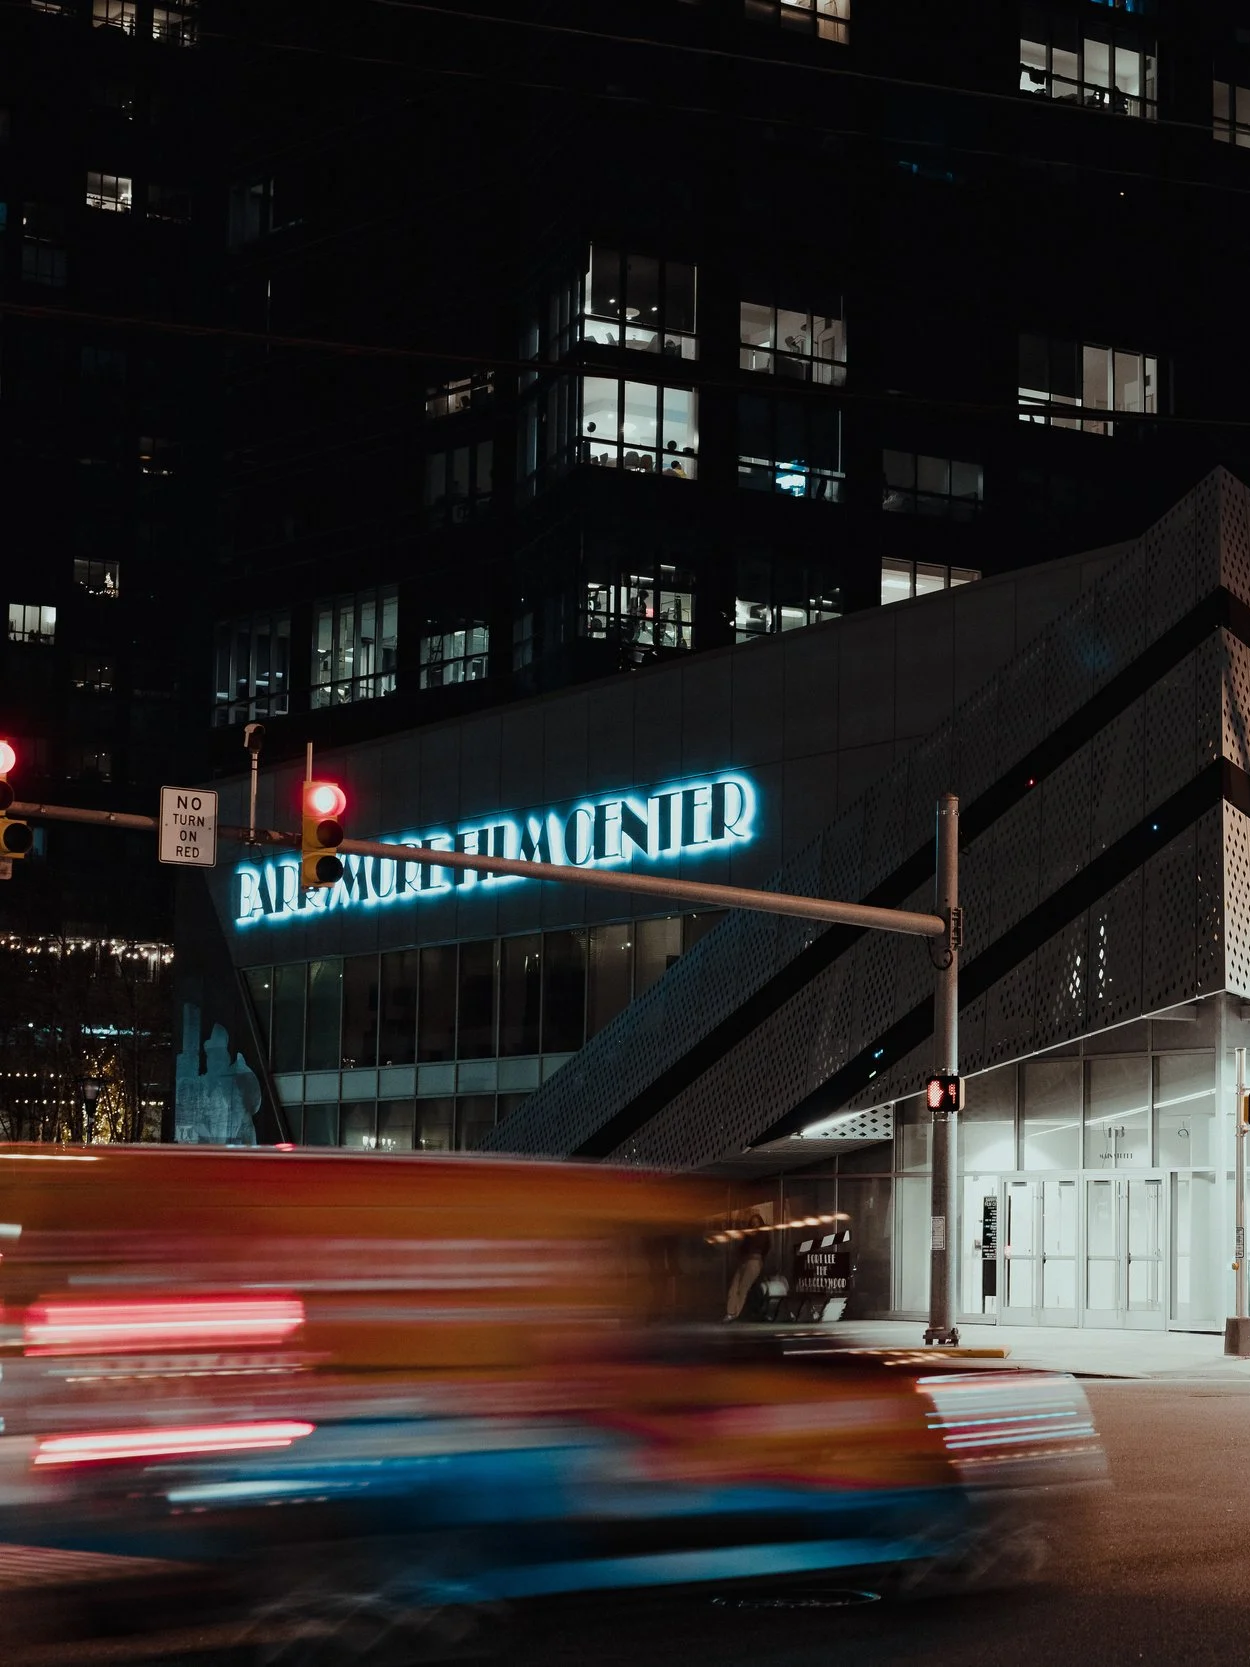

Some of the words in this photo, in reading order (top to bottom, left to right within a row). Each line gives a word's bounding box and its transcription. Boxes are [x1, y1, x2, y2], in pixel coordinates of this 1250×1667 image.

[177, 795, 202, 811] NO
[173, 813, 205, 827] TURN
[180, 830, 197, 842] ON
[176, 846, 200, 858] RED
[234, 836, 448, 919] BARRMORE
[565, 781, 745, 866] CENTER
[824, 1254, 836, 1264] LEE
